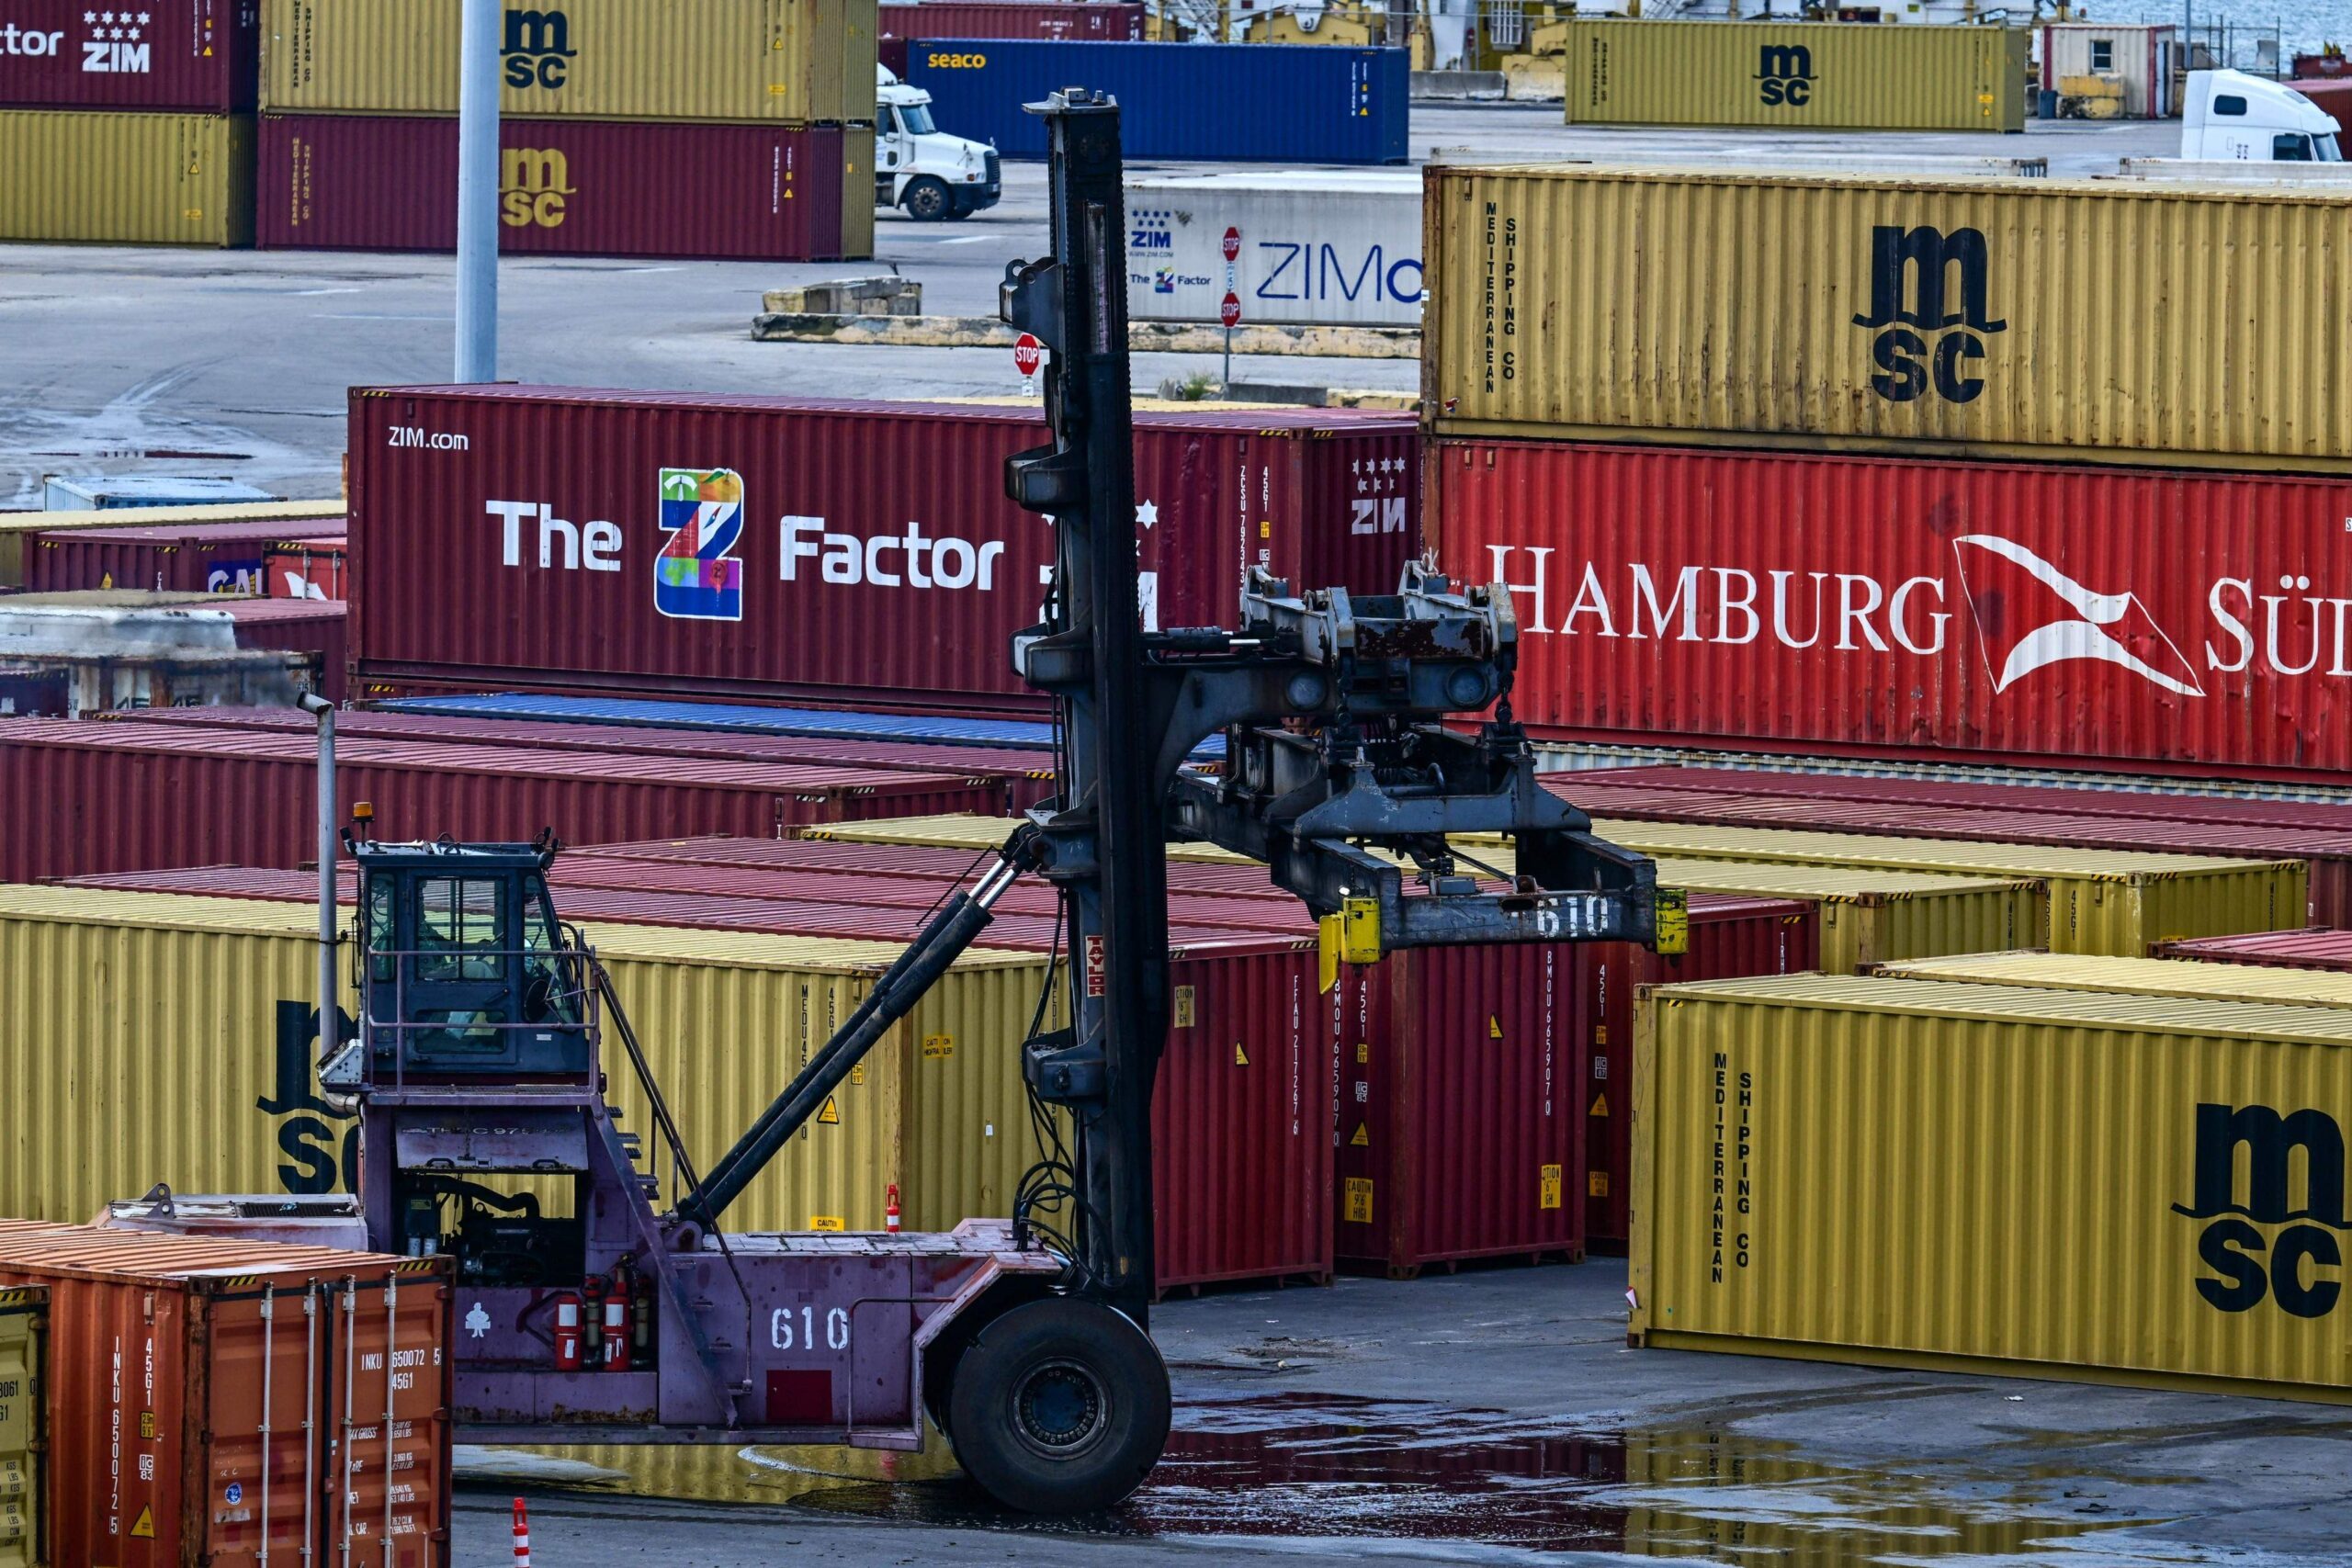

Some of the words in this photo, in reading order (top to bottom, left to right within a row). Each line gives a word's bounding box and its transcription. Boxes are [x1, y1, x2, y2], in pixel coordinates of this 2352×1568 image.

[0, 23, 64, 56] tor
[83, 42, 151, 73] ZIM
[928, 52, 987, 69] seaco
[1130, 231, 1171, 248] ZIM
[1223, 238, 1239, 251] STOP
[1131, 275, 1150, 284] The
[1177, 276, 1211, 286] Factor
[1503, 218, 1516, 335] SHIPPING
[1222, 303, 1238, 317] STOP
[1485, 202, 1497, 393] MEDITERRANEAN
[1016, 346, 1038, 363] STOP
[1501, 351, 1515, 379] CO
[389, 426, 469, 451] ZIM.com
[486, 500, 623, 571] The
[780, 514, 1004, 591] Factor
[1486, 545, 1953, 655] HAMBURG
[1536, 895, 1609, 939] 610
[1087, 936, 1105, 996] TAYLOR
[1736, 1072, 1751, 1214] SHIPPING
[1712, 1052, 1726, 1283] MEDITERRANEAN
[1736, 1233, 1749, 1268] CO
[772, 1306, 849, 1349] 610
[112, 1336, 121, 1404] INKU
[144, 1337, 153, 1406] 45G1
[361, 1352, 382, 1371] INKU
[392, 1349, 424, 1368] 650072
[392, 1372, 413, 1390] 45G1
[111, 1408, 119, 1510] 650072
[140, 1470, 153, 1481] 83
